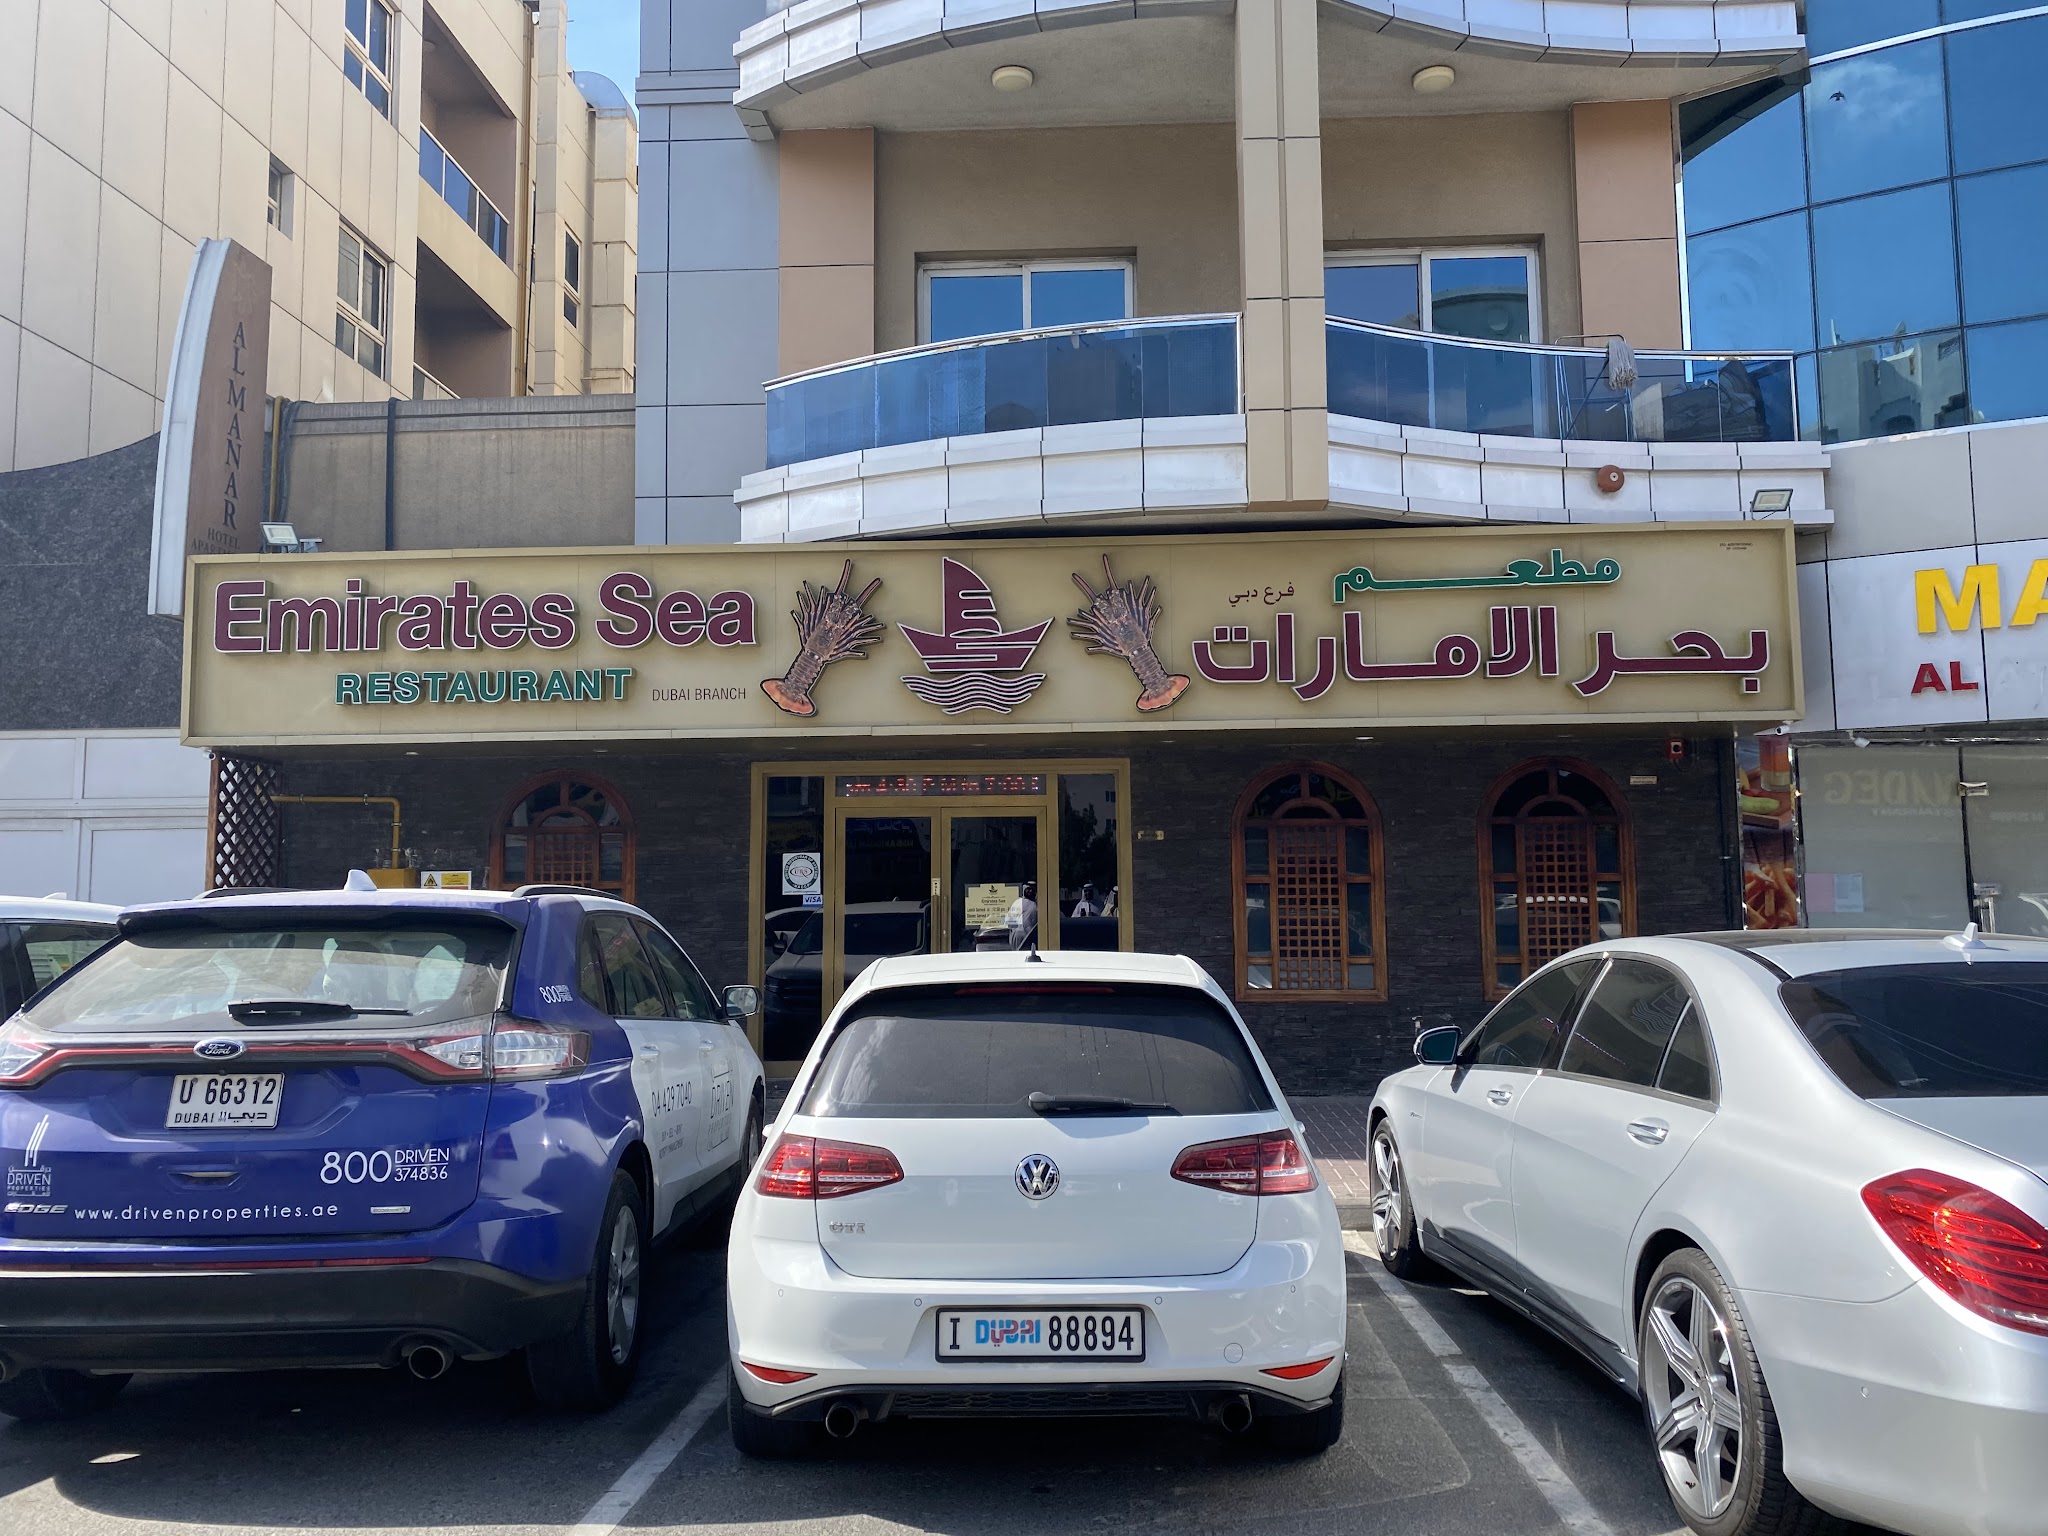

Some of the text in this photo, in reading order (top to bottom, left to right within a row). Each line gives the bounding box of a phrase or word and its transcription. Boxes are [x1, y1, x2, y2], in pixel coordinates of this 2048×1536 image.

[208, 527, 240, 550] HOTEL
[1333, 548, 1621, 604] مطعم
[1228, 581, 1295, 607] فرع دبي
[214, 571, 757, 653] Emirates Sea
[1192, 605, 1770, 701] بحر الامارات
[335, 667, 633, 704] RESTAURANT
[1911, 661, 1979, 694] AL
[652, 687, 747, 702] DUBAI BRANCH
[205, 1043, 231, 1055] Ford
[179, 1078, 277, 1105] U 66312
[174, 1112, 215, 1124] DUBAI
[228, 1112, 267, 1123] دبي
[320, 1147, 450, 1184] 800 DRIVEN
[394, 1165, 448, 1182] 374836
[7, 1172, 52, 1186] DRIVEN
[74, 1203, 339, 1222] www.drivenproperties.ae
[829, 1220, 866, 1234] GTI
[949, 1317, 961, 1350] I
[1048, 1315, 1134, 1351] 88894
